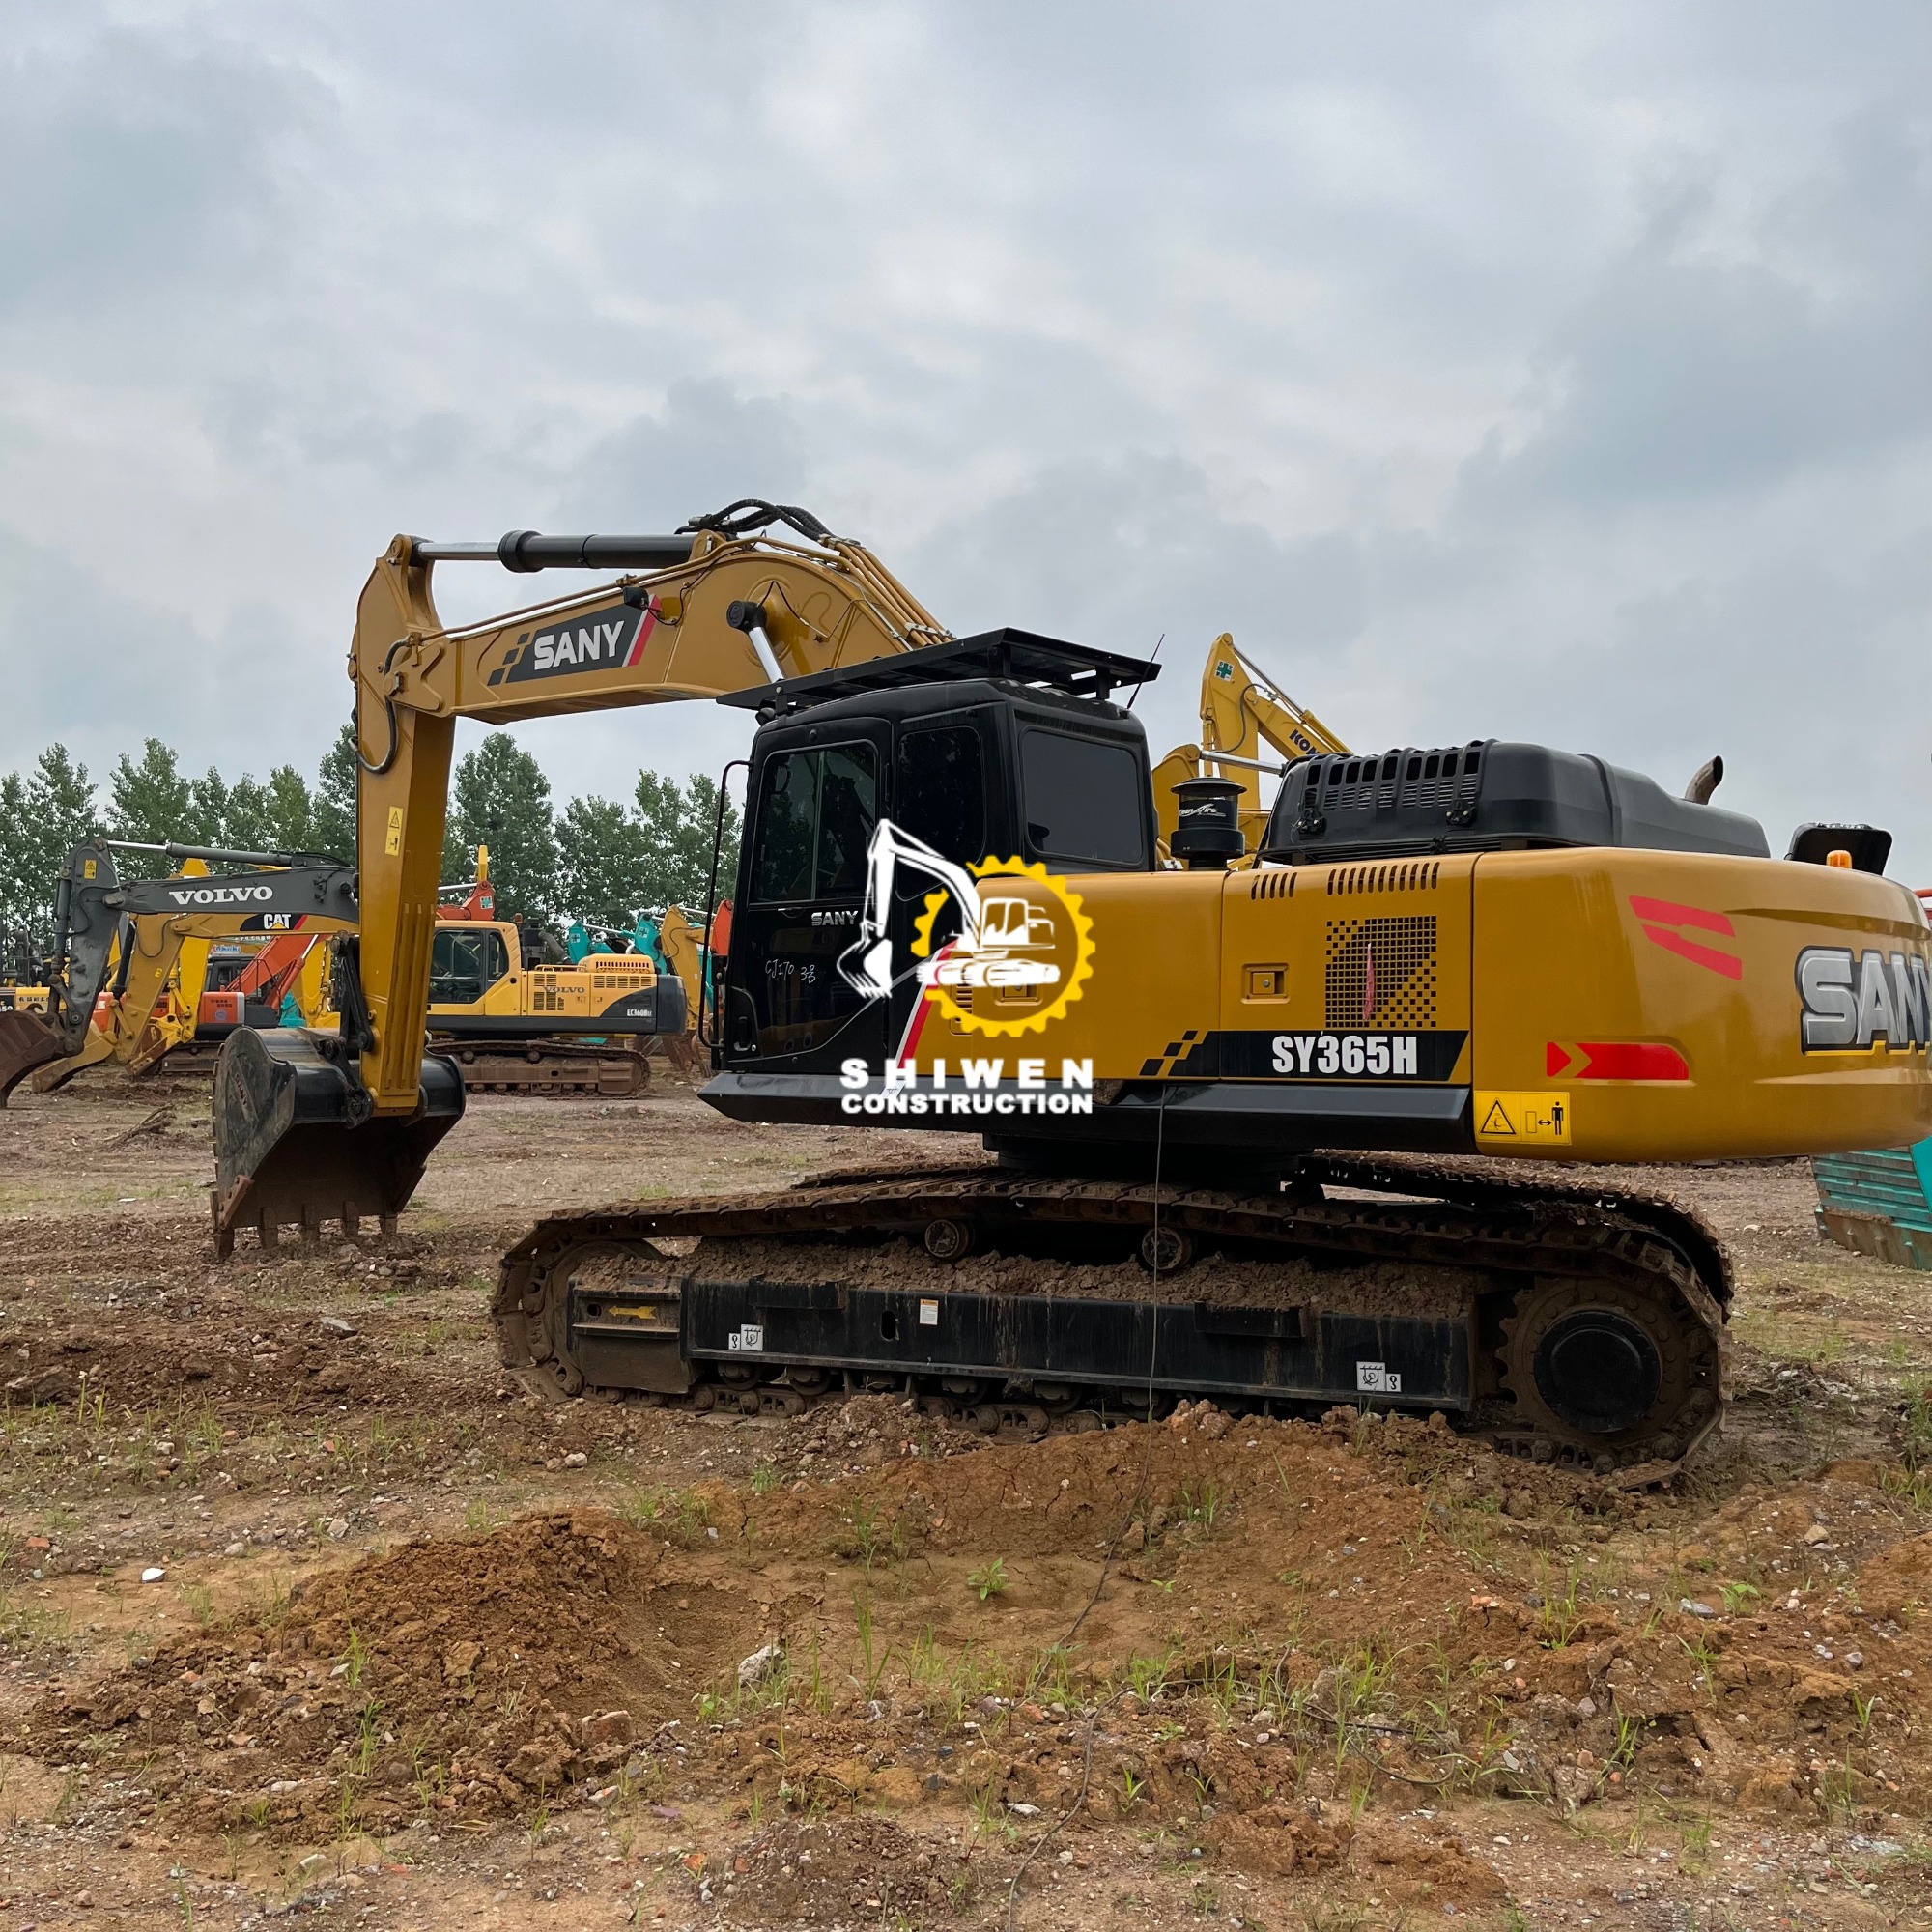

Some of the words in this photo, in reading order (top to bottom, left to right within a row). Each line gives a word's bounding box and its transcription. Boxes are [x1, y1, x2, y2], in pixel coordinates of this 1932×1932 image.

[533, 620, 625, 670] SANY
[169, 886, 273, 905] VOLVO
[263, 914, 291, 930] CAT
[810, 910, 859, 927] SANY
[1272, 1035, 1417, 1074] SY365H
